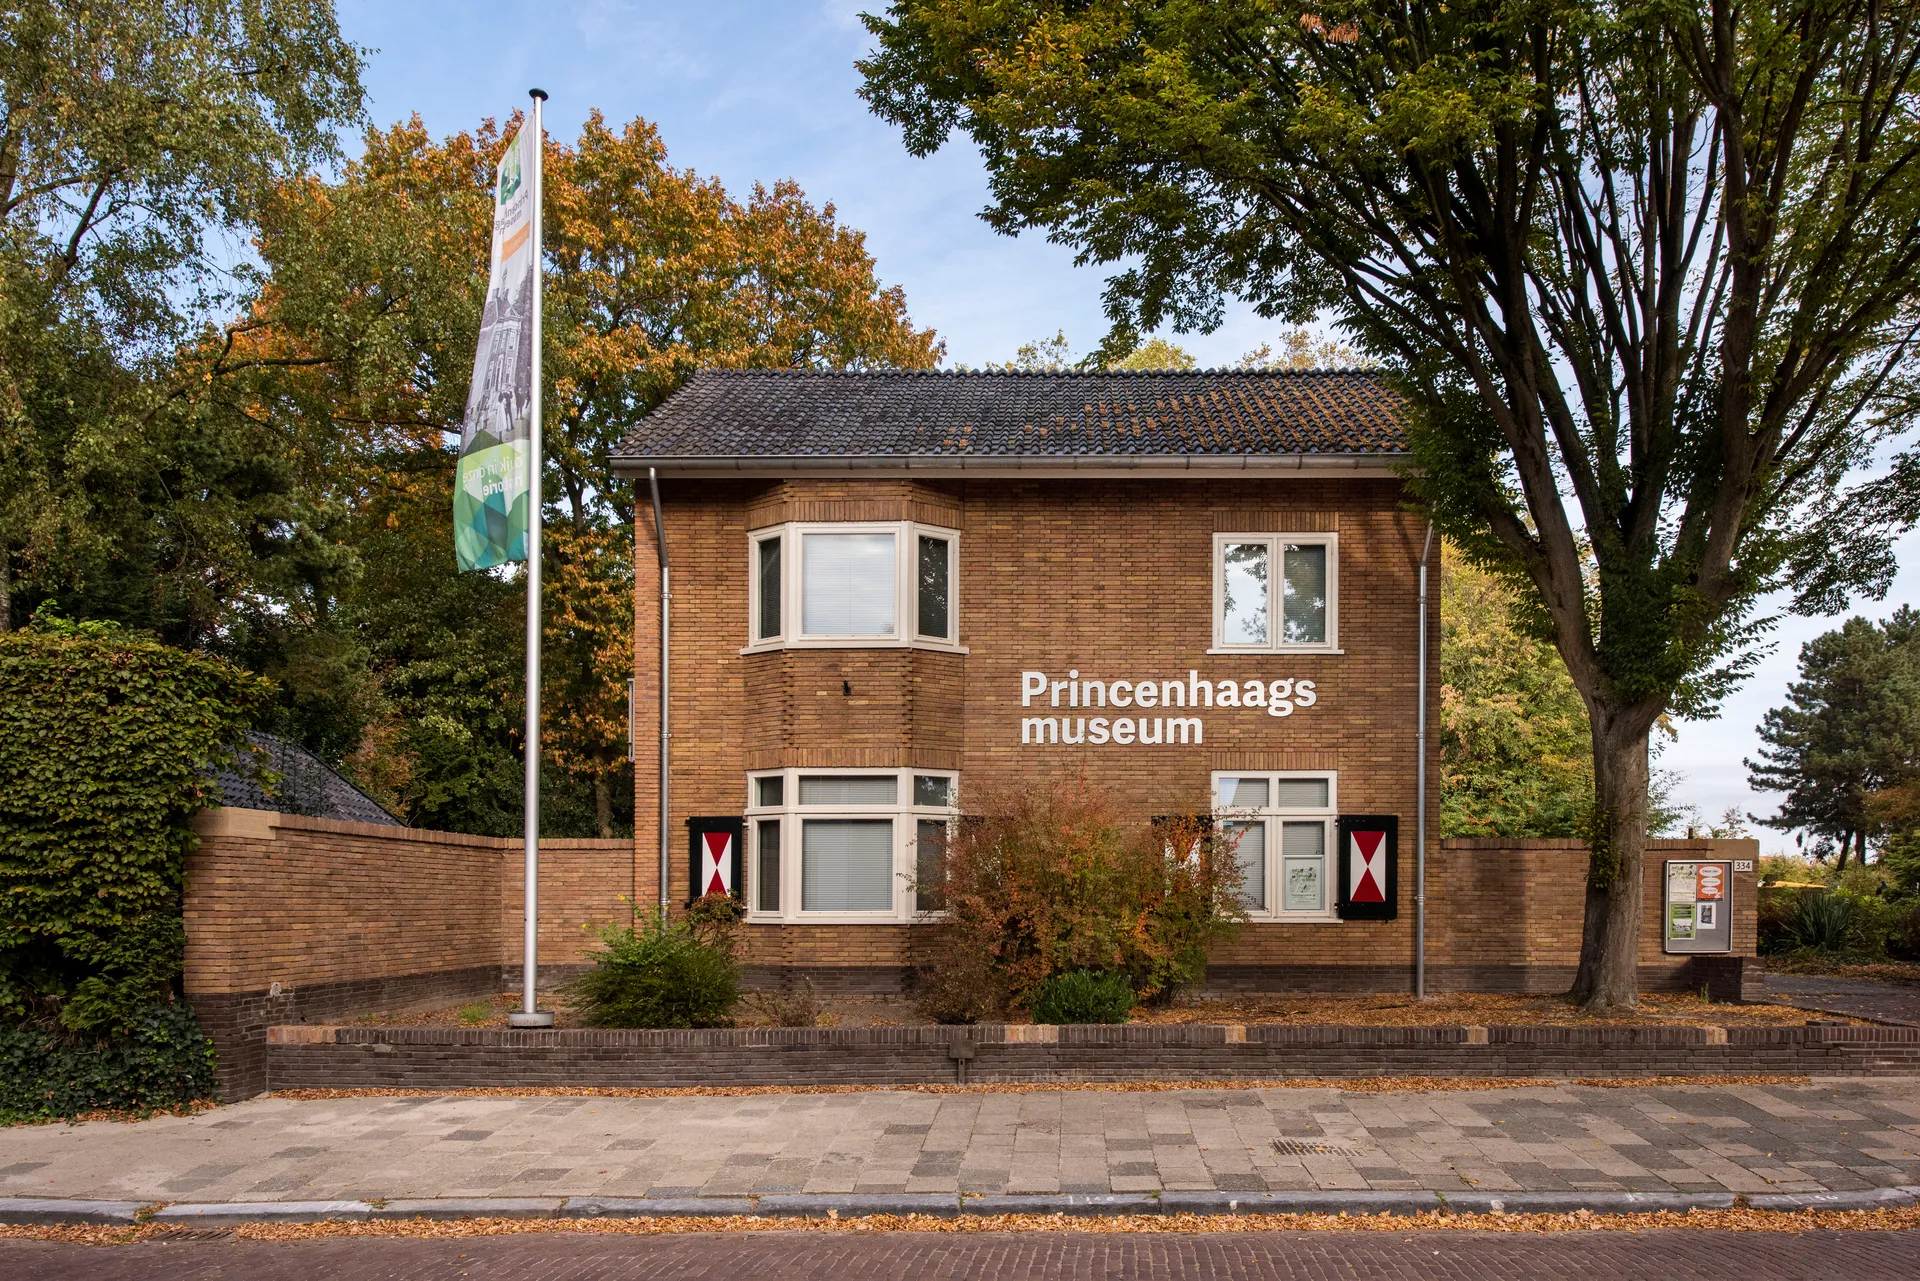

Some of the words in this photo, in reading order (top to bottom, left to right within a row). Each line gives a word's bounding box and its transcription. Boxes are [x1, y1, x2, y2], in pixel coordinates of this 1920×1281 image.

[1022, 669, 1317, 717] Princenhaags
[1022, 717, 1203, 745] museum
[1736, 862, 1750, 870] 334
